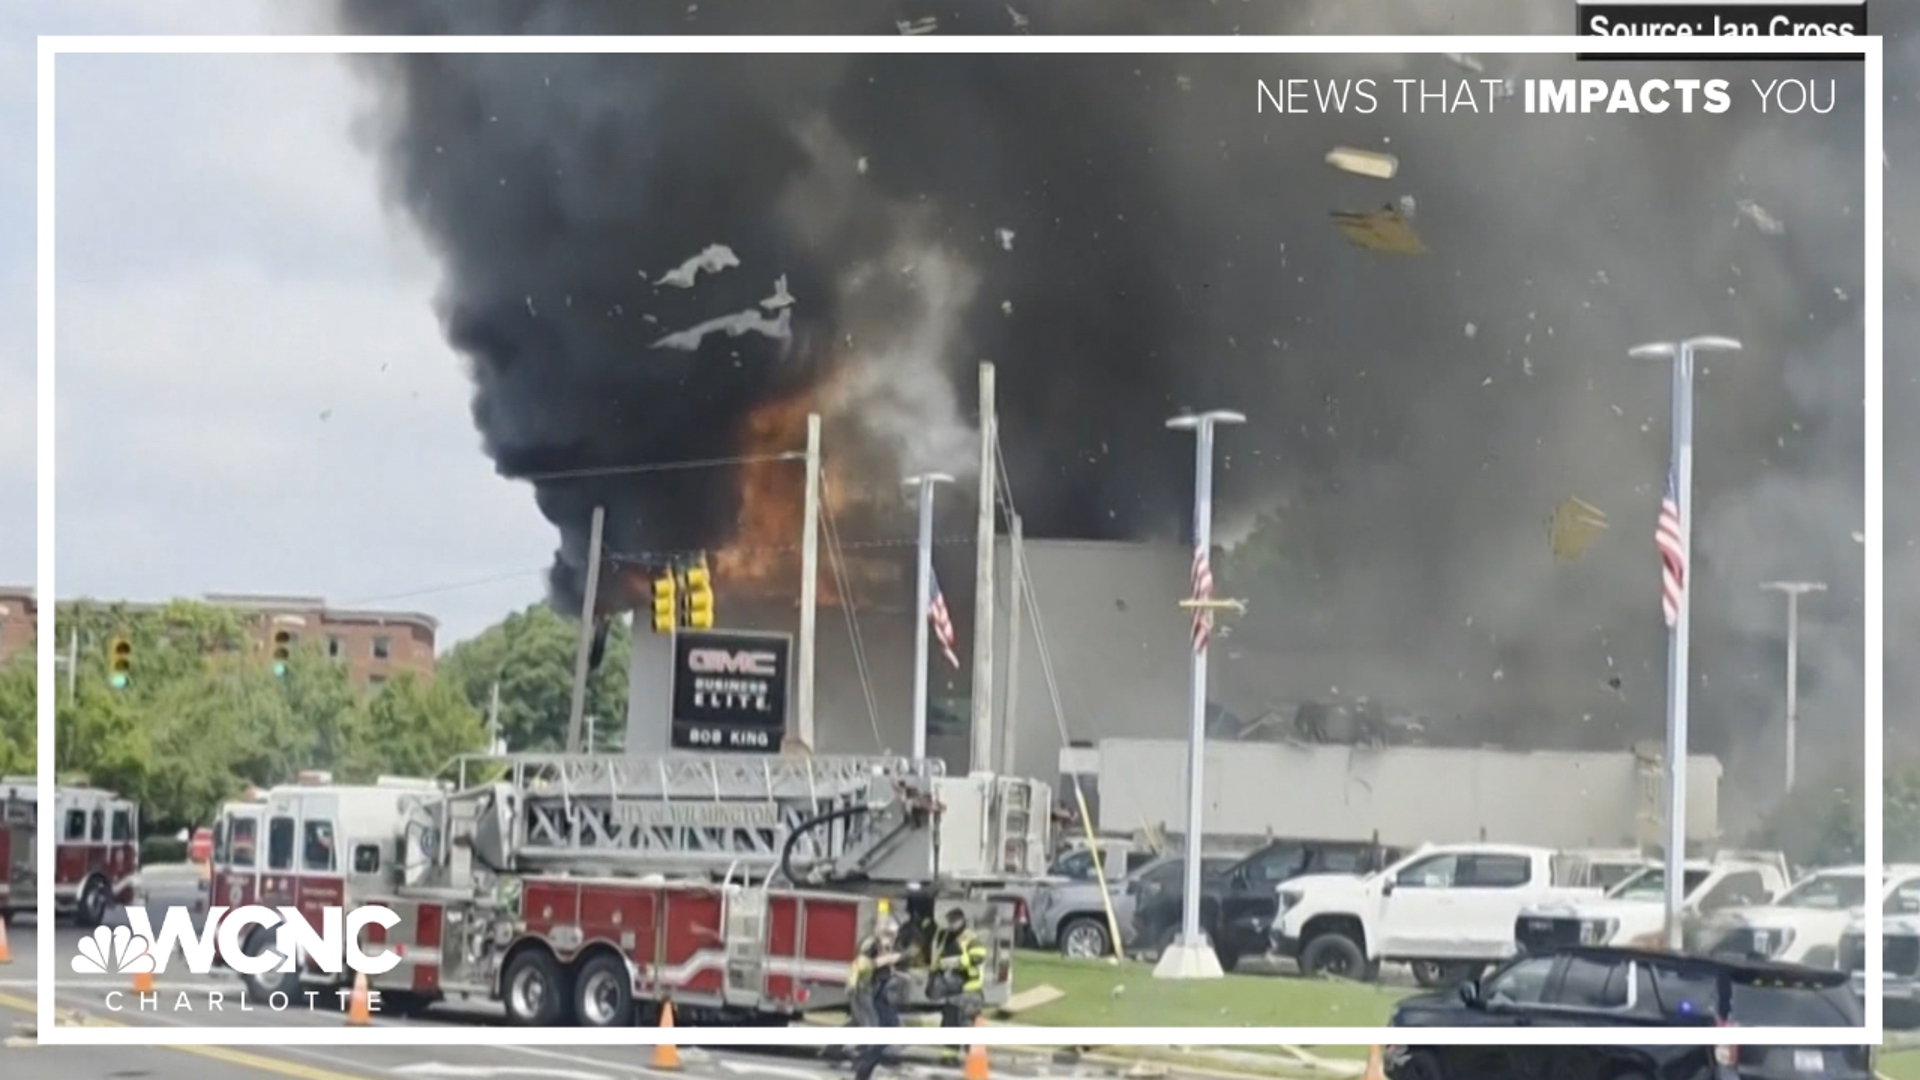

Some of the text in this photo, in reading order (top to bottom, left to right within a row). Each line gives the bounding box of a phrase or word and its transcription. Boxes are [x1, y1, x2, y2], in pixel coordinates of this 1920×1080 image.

[688, 649, 776, 675] GMC
[689, 728, 769, 747] BOB KING
